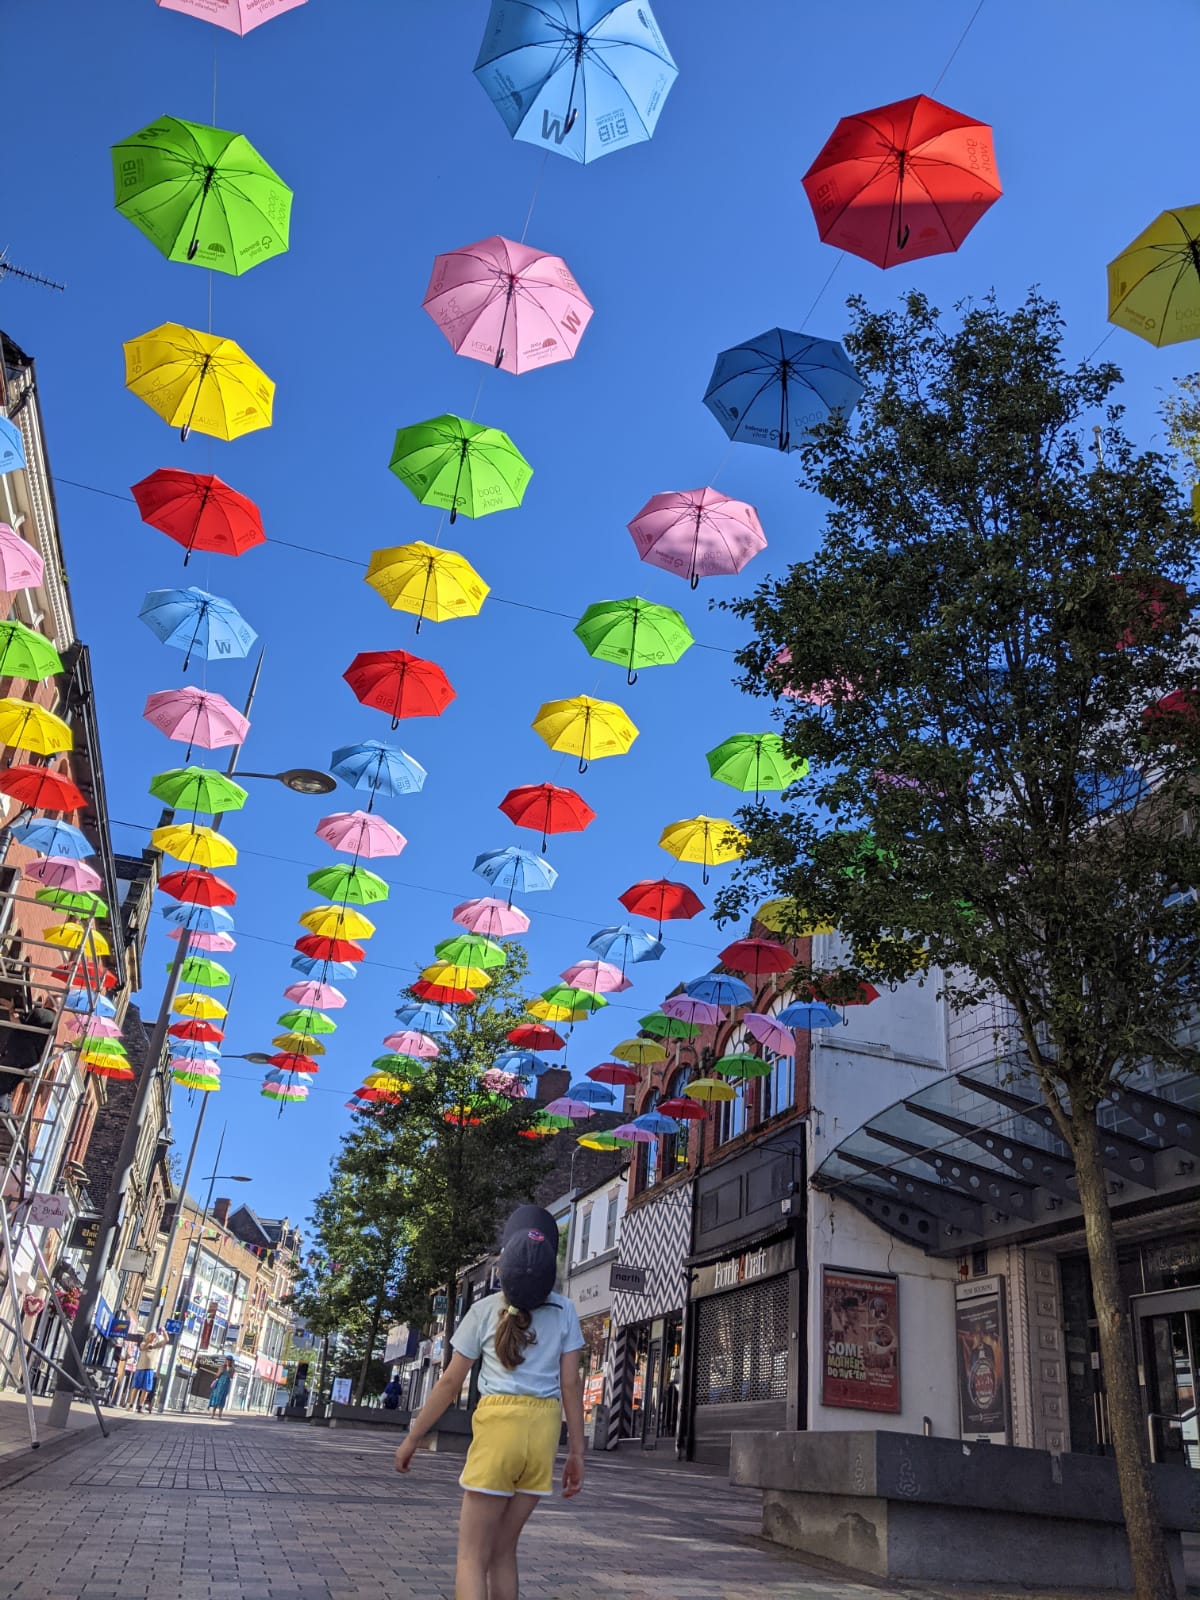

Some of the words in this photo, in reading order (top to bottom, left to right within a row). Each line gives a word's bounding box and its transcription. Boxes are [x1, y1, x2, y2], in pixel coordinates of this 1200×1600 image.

[714, 1257, 740, 1289] Bottle
[744, 1246, 767, 1280] Craft
[615, 1273, 640, 1284] north
[828, 1340, 864, 1359] SOME
[827, 1355, 866, 1371] MOTHERS
[827, 1368, 838, 1378] DO
